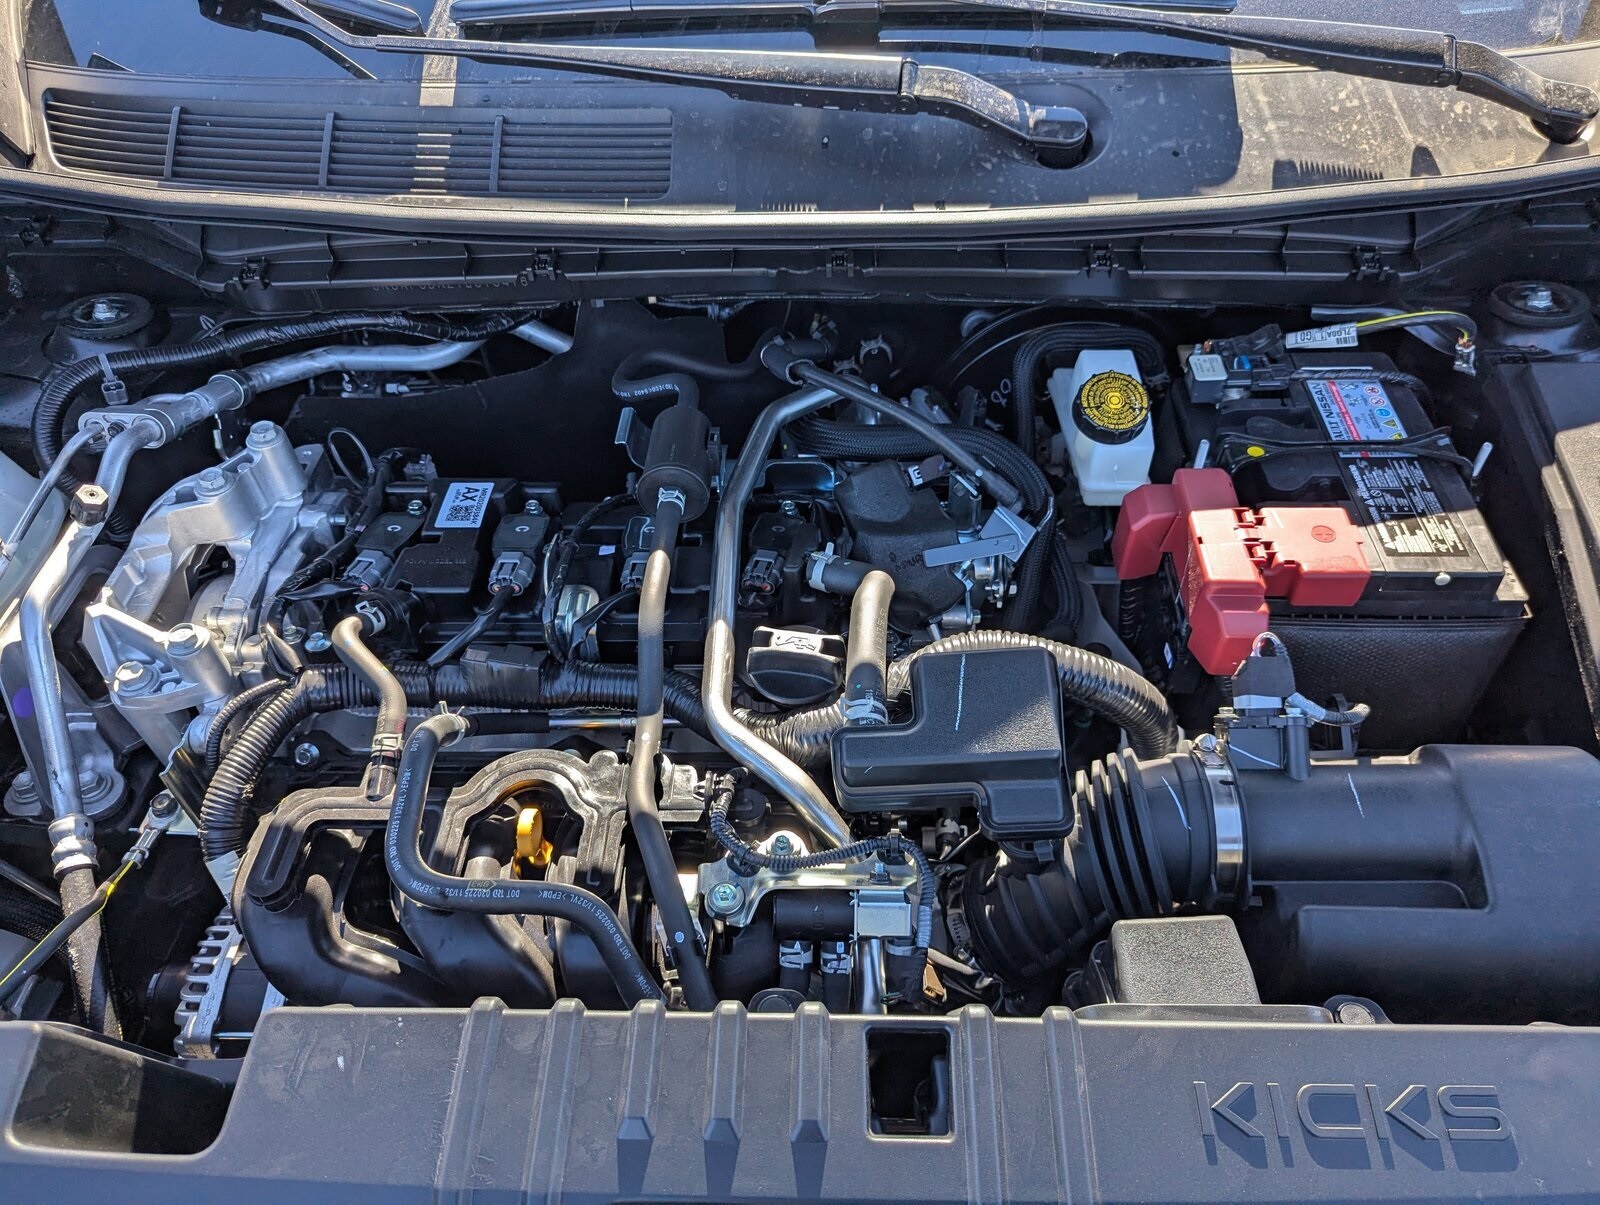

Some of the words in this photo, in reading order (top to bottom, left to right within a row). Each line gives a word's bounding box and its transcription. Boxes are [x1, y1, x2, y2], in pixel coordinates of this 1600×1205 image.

[1311, 383, 1334, 418] NISSAN
[460, 486, 480, 502] AX
[391, 857, 401, 872] DOT
[507, 888, 520, 898] DOT
[596, 908, 616, 935] 030225
[620, 945, 632, 960] DOT
[1193, 1081, 1513, 1141] KICKS
